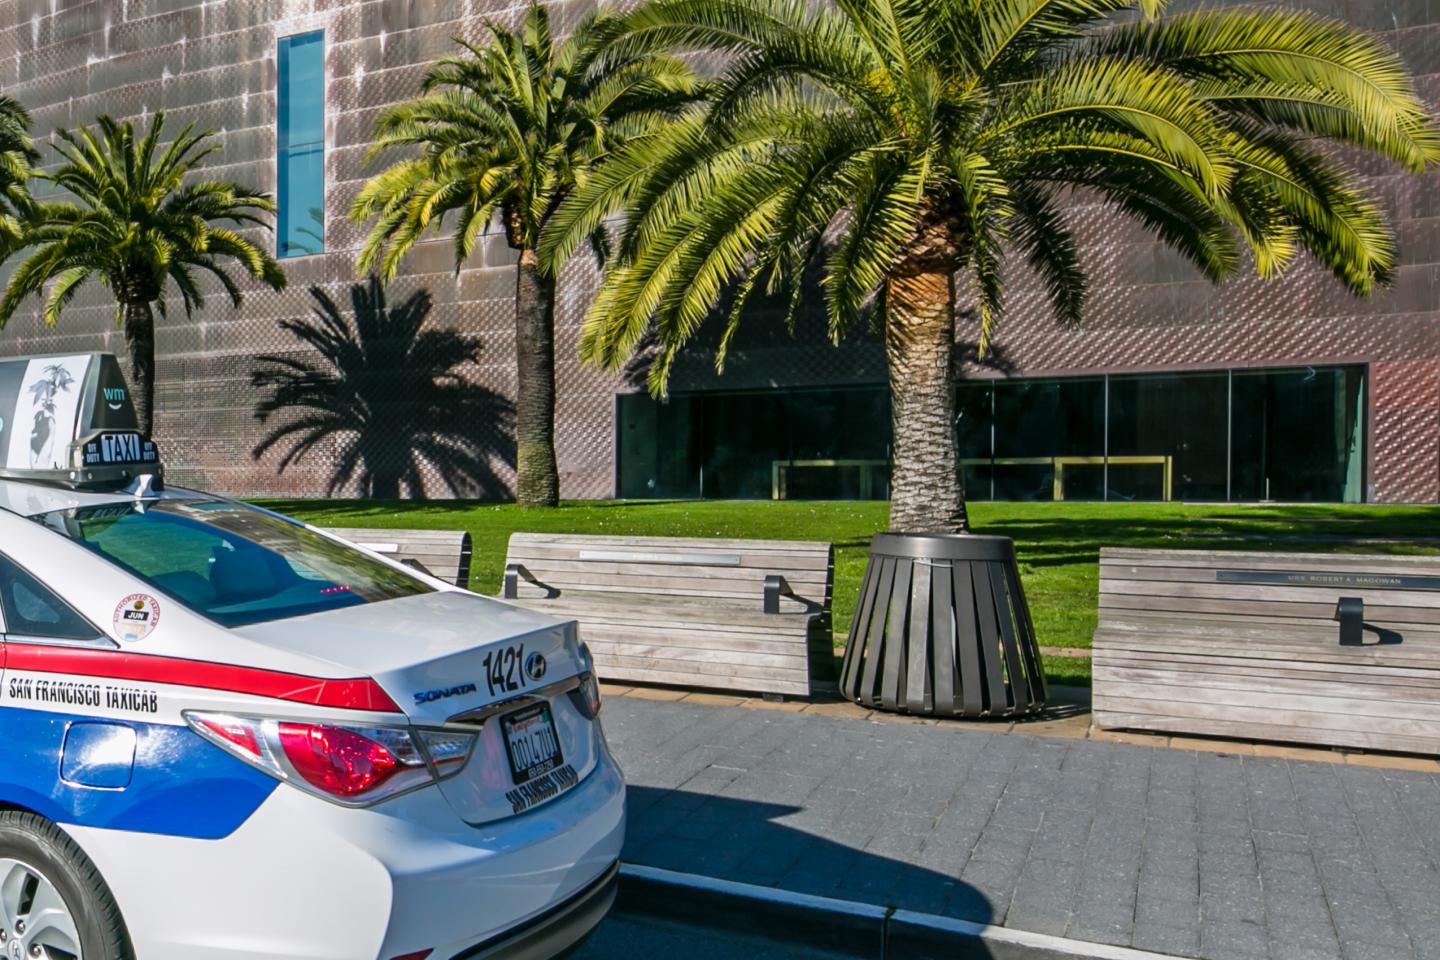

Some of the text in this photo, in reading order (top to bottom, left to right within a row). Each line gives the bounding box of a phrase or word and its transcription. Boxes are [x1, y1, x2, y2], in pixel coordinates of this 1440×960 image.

[103, 387, 125, 401] wm
[102, 433, 141, 462] TAXI
[127, 612, 145, 620] JUN
[482, 643, 526, 697] 1421
[9, 678, 158, 713] SAN FRANCISCO TAXICAB
[413, 683, 477, 706] SONATA
